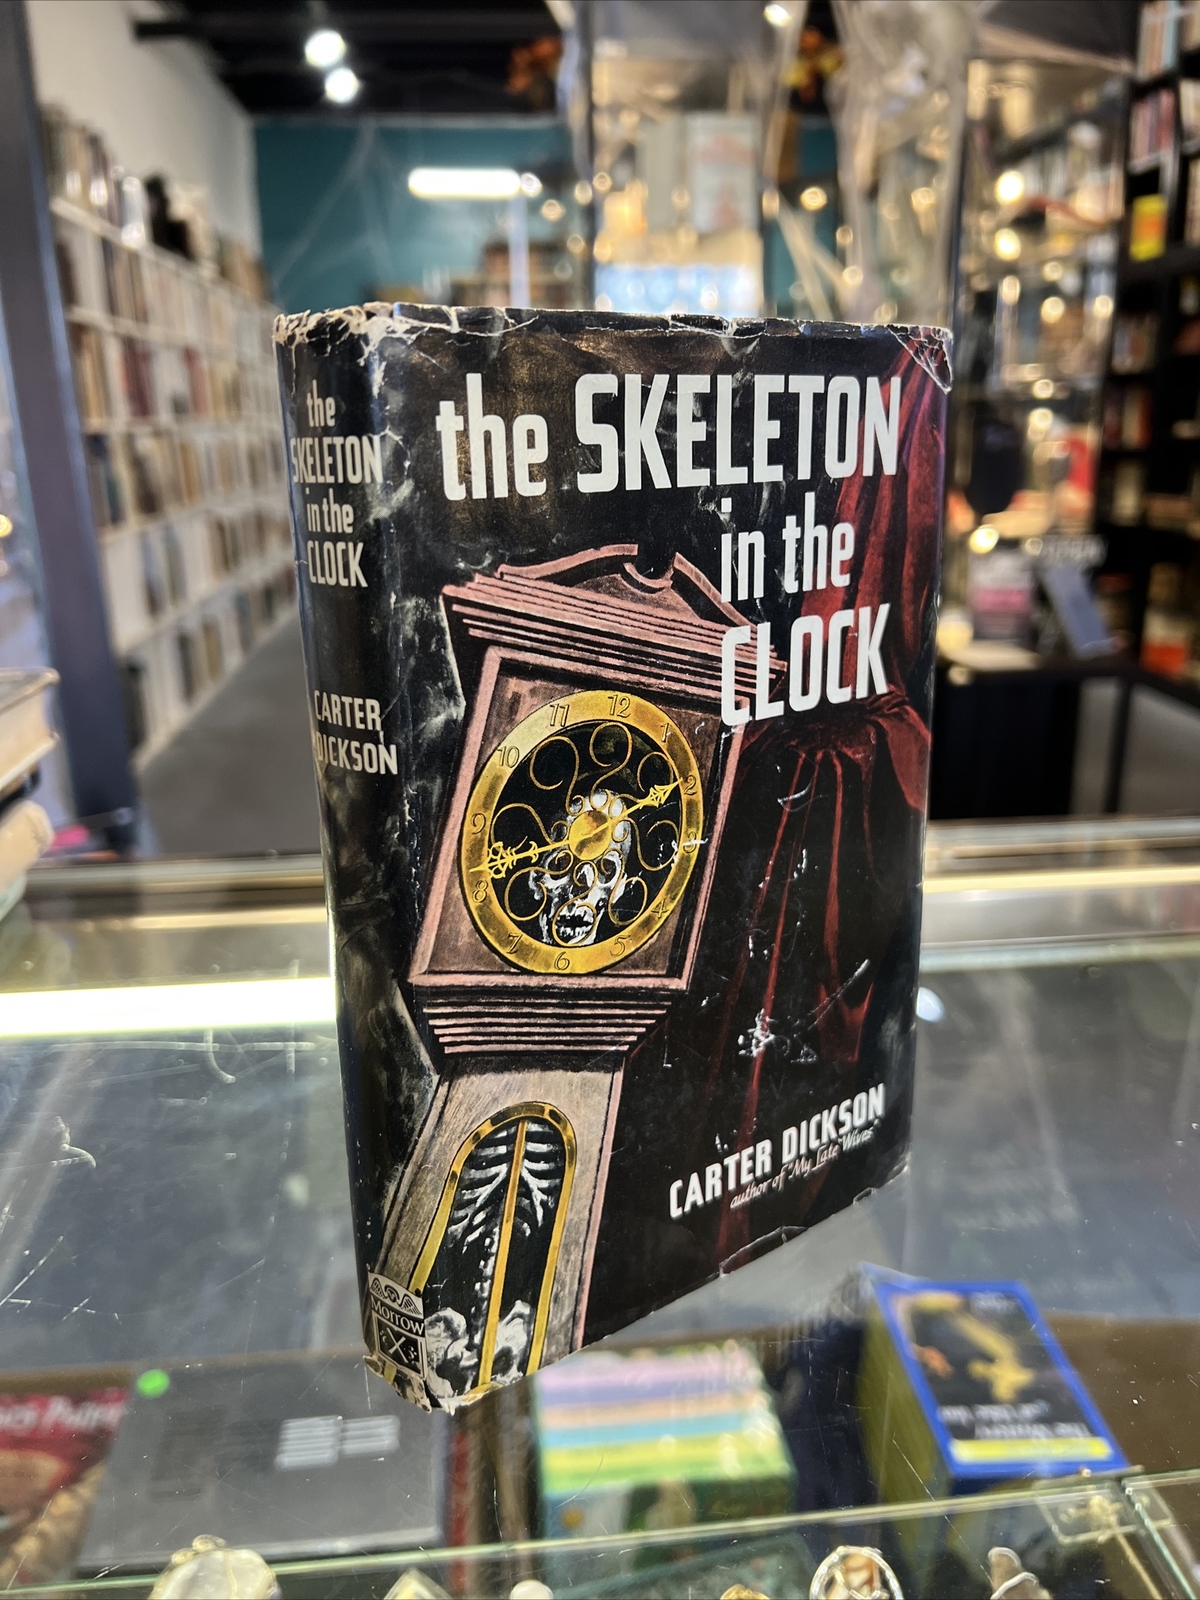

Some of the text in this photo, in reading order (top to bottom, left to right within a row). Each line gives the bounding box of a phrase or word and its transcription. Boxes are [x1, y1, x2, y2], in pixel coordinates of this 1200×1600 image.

[306, 378, 336, 428] the
[435, 372, 901, 501] the SKELETON
[290, 434, 384, 484] SKELETON
[305, 486, 354, 534] in the
[306, 540, 369, 588] CLOCK
[720, 491, 856, 603] in the
[720, 602, 891, 727] CLOCK
[313, 689, 382, 732] CARTER
[549, 702, 570, 728] 11
[607, 693, 632, 719] 12
[660, 722, 672, 744] 1
[315, 730, 399, 775] DICKSON
[496, 744, 521, 769] 10
[682, 773, 698, 796] 2
[470, 812, 487, 835] 9
[472, 878, 489, 904] 8
[650, 904, 669, 919] 4
[505, 932, 523, 954] 7
[609, 935, 632, 957] 5
[553, 950, 571, 972] 6
[669, 1082, 886, 1220] CARTER DICKSON
[729, 1178, 773, 1210] author
[772, 1163, 788, 1192] of
[811, 1142, 840, 1173] Late
